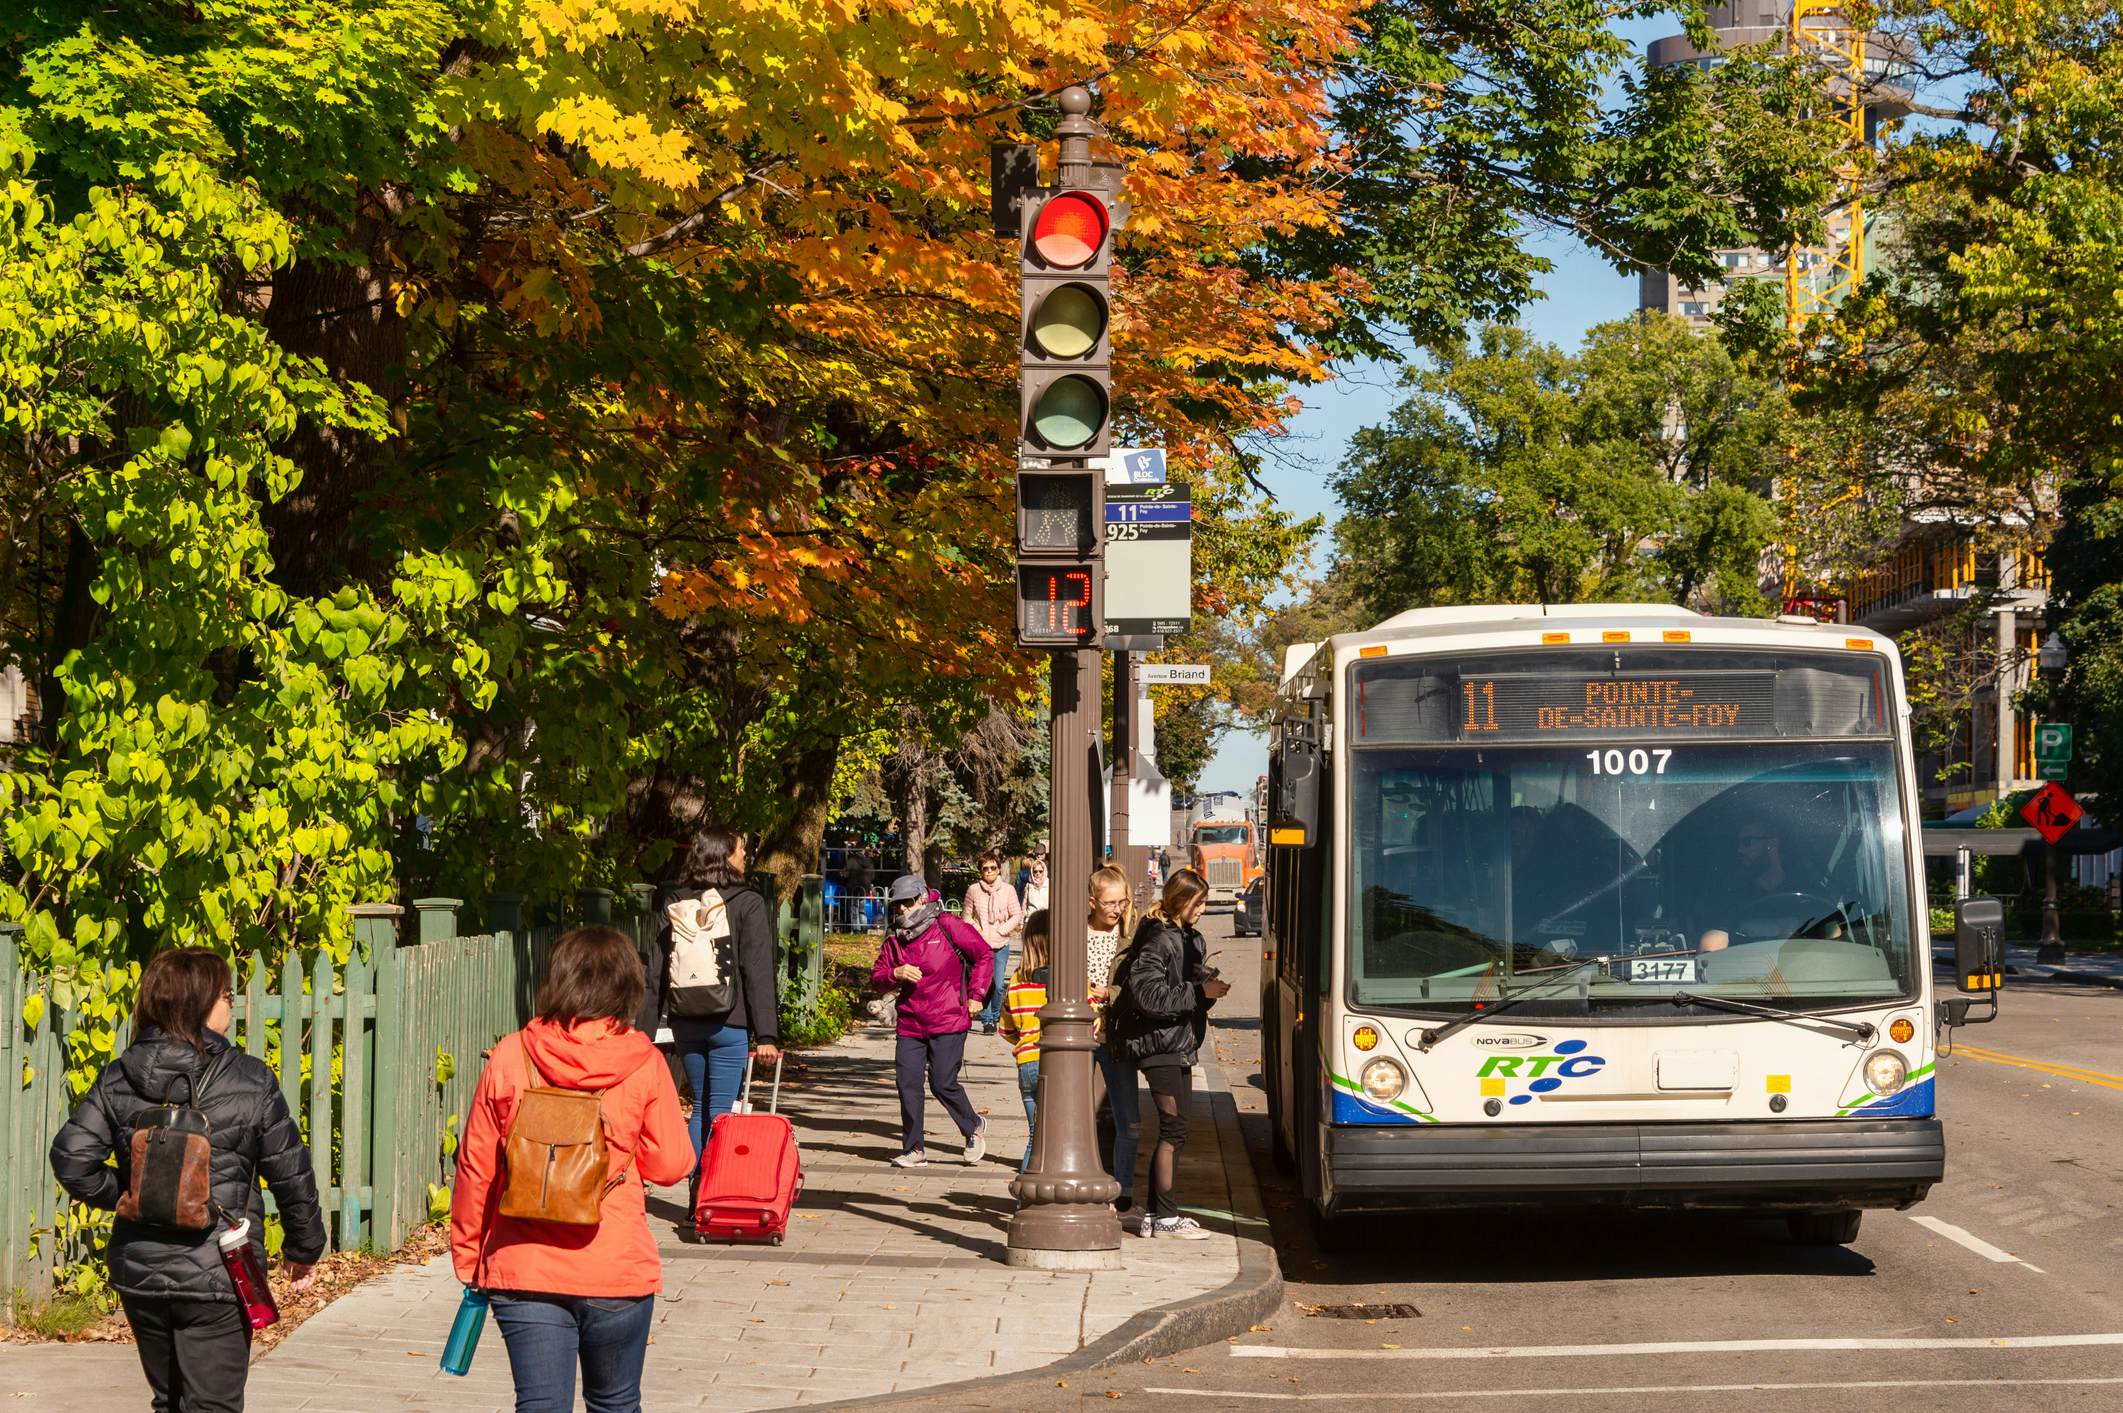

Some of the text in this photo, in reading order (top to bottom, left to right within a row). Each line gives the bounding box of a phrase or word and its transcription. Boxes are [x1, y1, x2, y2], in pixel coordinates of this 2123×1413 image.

[1145, 488, 1175, 496] RTC
[1118, 504, 1137, 521] 11
[1107, 524, 1139, 541] 925
[1049, 571, 1090, 635] 12
[1169, 669, 1205, 679] Briand
[1586, 681, 1694, 704] POINTE-
[1463, 681, 1499, 730] 11
[1537, 704, 1740, 730] DE-SAINTE-FOY
[2041, 729, 2063, 756] P
[1586, 749, 1673, 775] 1007
[1637, 962, 1688, 980] 3177
[1476, 1055, 1606, 1078] RTC
